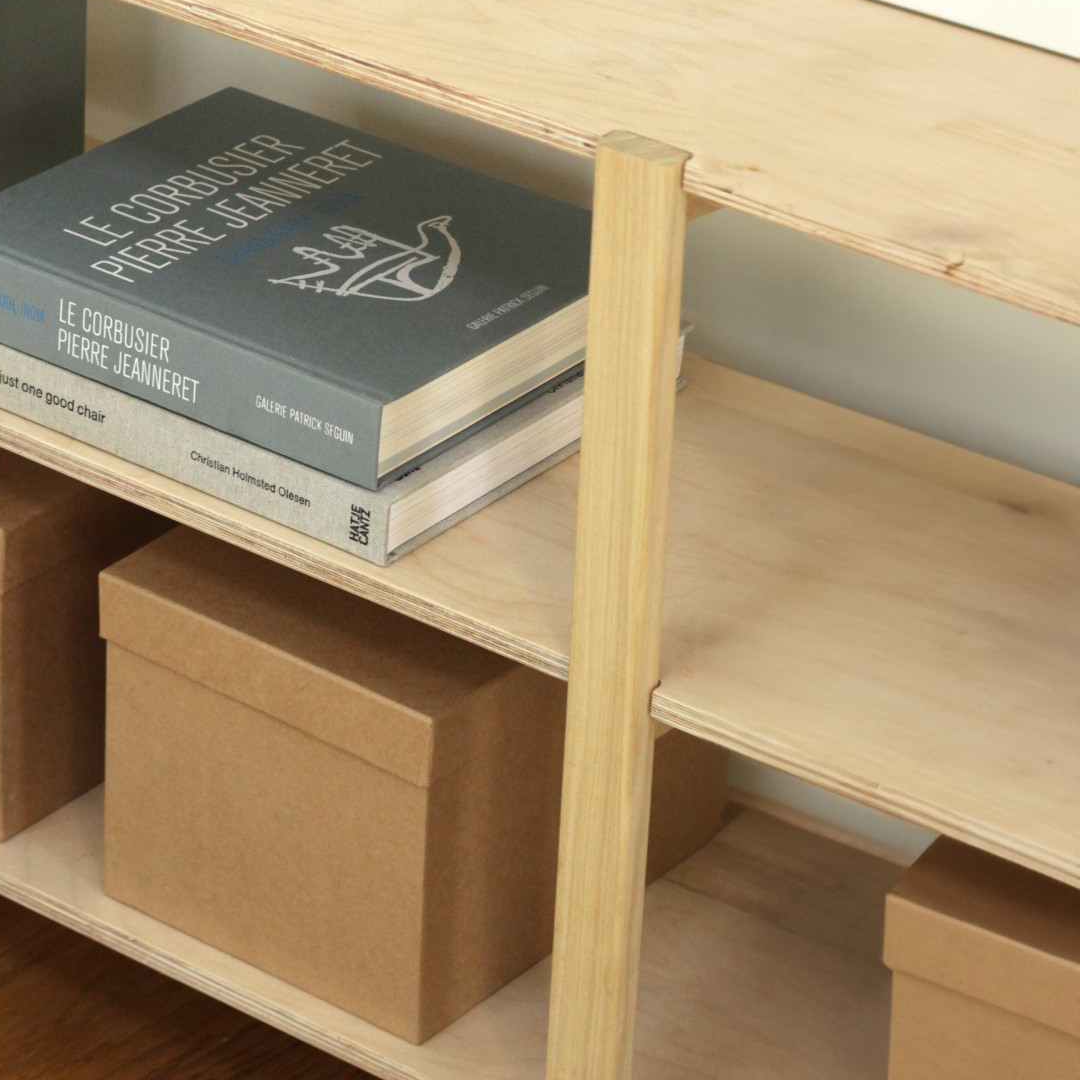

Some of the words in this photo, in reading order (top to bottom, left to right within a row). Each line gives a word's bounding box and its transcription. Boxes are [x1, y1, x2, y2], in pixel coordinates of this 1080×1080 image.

[63, 216, 134, 247] LE
[110, 134, 305, 224] CORBUSIER
[90, 219, 228, 283] PIERRE
[206, 139, 383, 229] JEANNERET
[20, 302, 46, 324] INDIA
[58, 298, 77, 327] LE
[82, 307, 170, 363] CORBUSIER
[57, 328, 109, 370] PIERRE
[113, 351, 200, 404] JEANNERET
[21, 382, 43, 398] one
[45, 392, 75, 412] good
[77, 404, 106, 424] chair
[255, 395, 287, 419] GALERIE
[289, 408, 322, 432] PATRICK
[324, 422, 354, 445] SEGUIN
[190, 450, 230, 475] Christian
[232, 467, 276, 493] Holmsted
[278, 486, 311, 508] Olesen
[349, 504, 362, 542] HATJE
[358, 509, 371, 546] CANTZ
